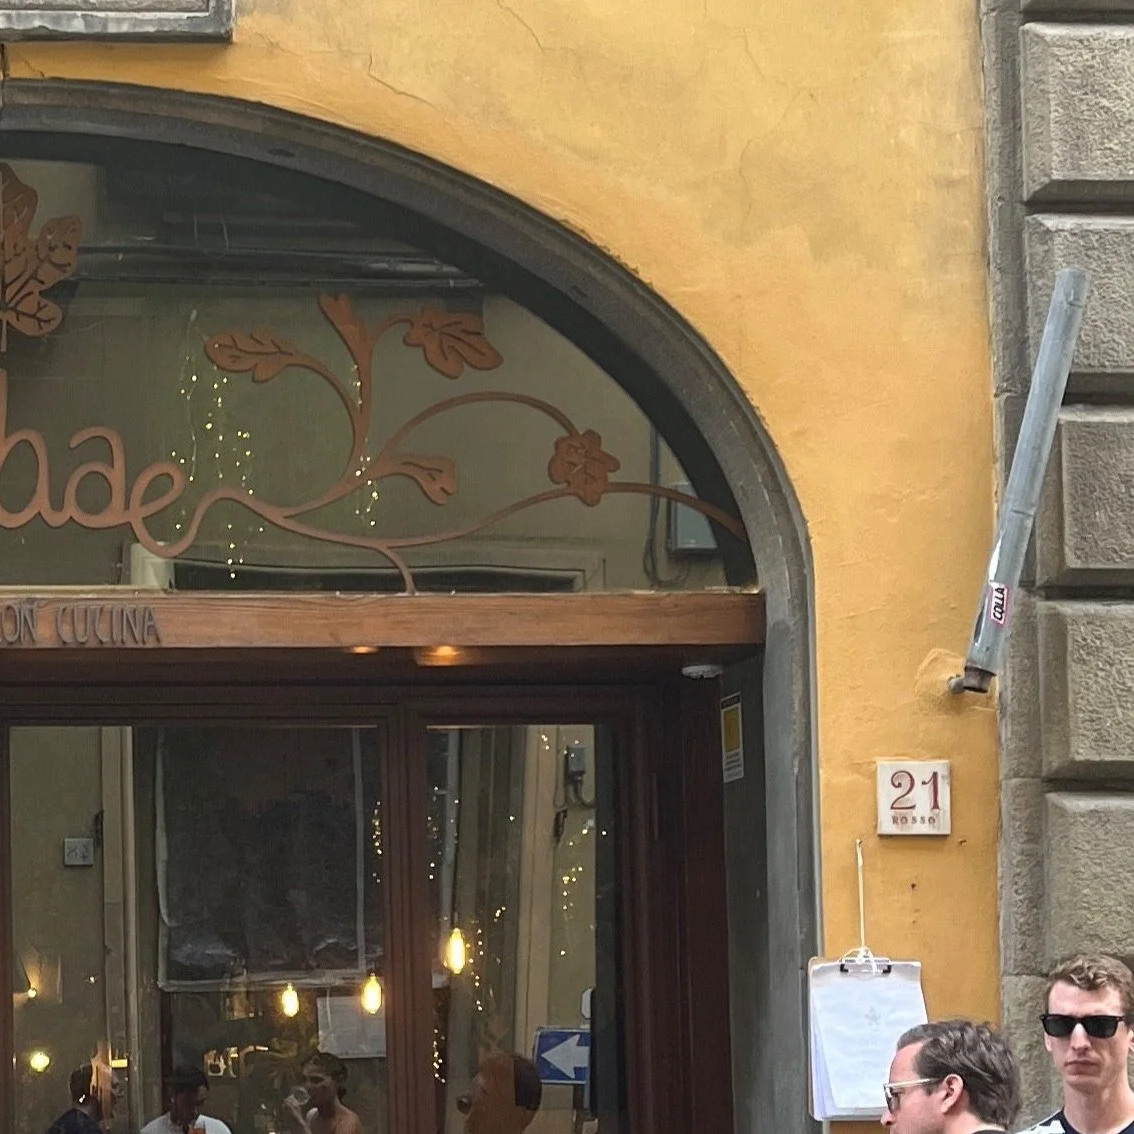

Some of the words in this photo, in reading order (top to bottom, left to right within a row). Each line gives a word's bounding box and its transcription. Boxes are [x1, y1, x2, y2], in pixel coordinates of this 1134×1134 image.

[992, 586, 1005, 621] COLLA
[56, 602, 162, 645] CUCINA
[890, 770, 941, 811] 21
[891, 815, 936, 826] ROSSO
